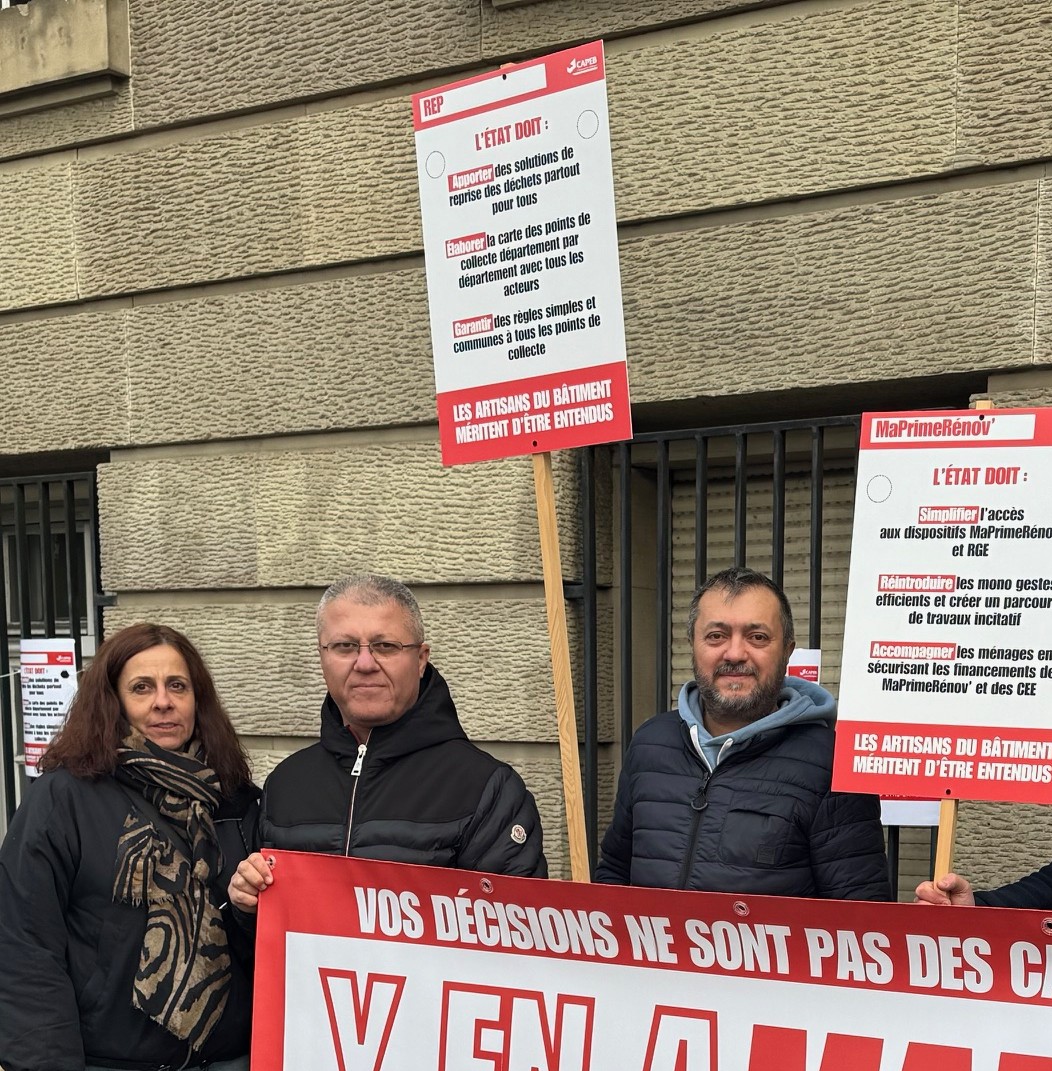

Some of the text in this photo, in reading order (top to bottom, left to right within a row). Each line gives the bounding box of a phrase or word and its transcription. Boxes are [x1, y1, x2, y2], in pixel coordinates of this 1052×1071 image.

[576, 56, 597, 68] CAPEB
[423, 96, 443, 116] REP
[475, 127, 511, 151] L'ÉTAT
[515, 117, 542, 141] DOIT
[452, 146, 573, 189] Apporter des solutions de
[450, 163, 580, 206] reprise des déchets partout
[492, 193, 537, 215] pour tous
[446, 212, 590, 255] Élaborer la carte des points de
[461, 234, 579, 270] collecte département par
[459, 251, 584, 288] département avec tous les
[504, 278, 539, 296] acteurs
[454, 296, 596, 336] Garantir des règles simples et
[453, 314, 601, 353] communes à tous les points de
[508, 343, 546, 360] collecte
[453, 379, 612, 422] LES ARTISANS DU BÂTIMENT
[455, 403, 614, 444] MÉRITENT D'ÊTRE ENTENDUS
[875, 417, 996, 438] MaPrimeRénov'
[933, 464, 981, 486] L'ÉTAT
[984, 466, 1021, 485] DOIT
[919, 507, 1025, 524] Simplifier l'accès
[880, 527, 900, 539] aux
[904, 525, 966, 541] dispositifs
[952, 543, 989, 557] et RGE
[880, 575, 954, 591] Réintroduire
[956, 576, 974, 590] les
[978, 578, 1012, 591] mono
[876, 594, 931, 607] efficients
[934, 595, 946, 607] et
[949, 594, 982, 608] créer
[985, 596, 1001, 608] un
[909, 611, 1022, 626] de travaux incitatif
[872, 643, 1052, 661] Accompagner les ménages en
[867, 662, 929, 676] sécurisant
[932, 662, 950, 676] les
[953, 663, 1036, 678] financements
[882, 678, 1037, 696] MaPrimeRénov' et des CEE
[854, 734, 878, 751] LES
[881, 735, 952, 755] ARTISANS
[955, 738, 977, 757] DU
[853, 753, 1052, 783] MÉRITENT D'ÊTRE ENTENDUS
[354, 886, 425, 939] VOS
[431, 888, 619, 959] DÉCISIONS
[623, 914, 678, 965] NE
[686, 918, 792, 975] SONT
[808, 929, 893, 986] PAS
[908, 935, 993, 995] DES
